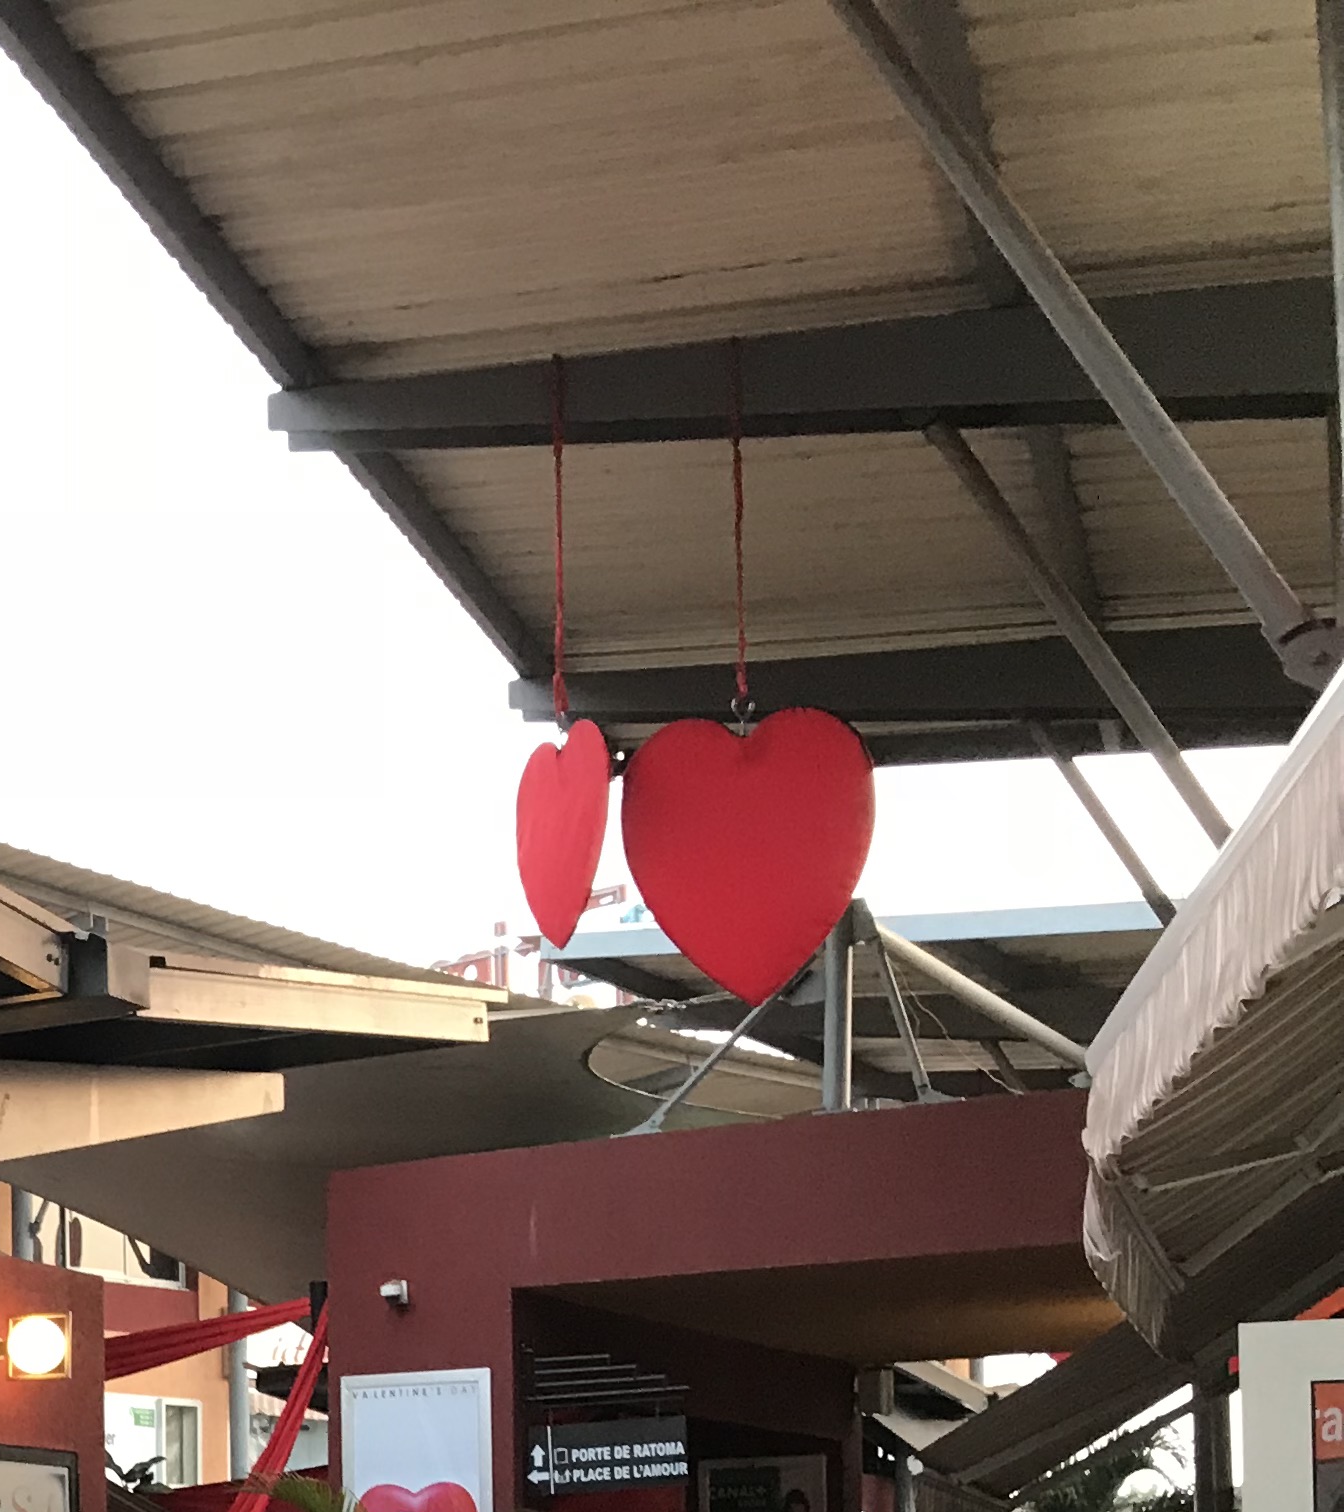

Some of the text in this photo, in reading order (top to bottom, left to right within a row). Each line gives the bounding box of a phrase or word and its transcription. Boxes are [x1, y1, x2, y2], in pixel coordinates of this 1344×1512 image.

[571, 1441, 686, 1463] PORTE DE RATOMA
[572, 1461, 689, 1483] PLACE DE L'AMOUR
